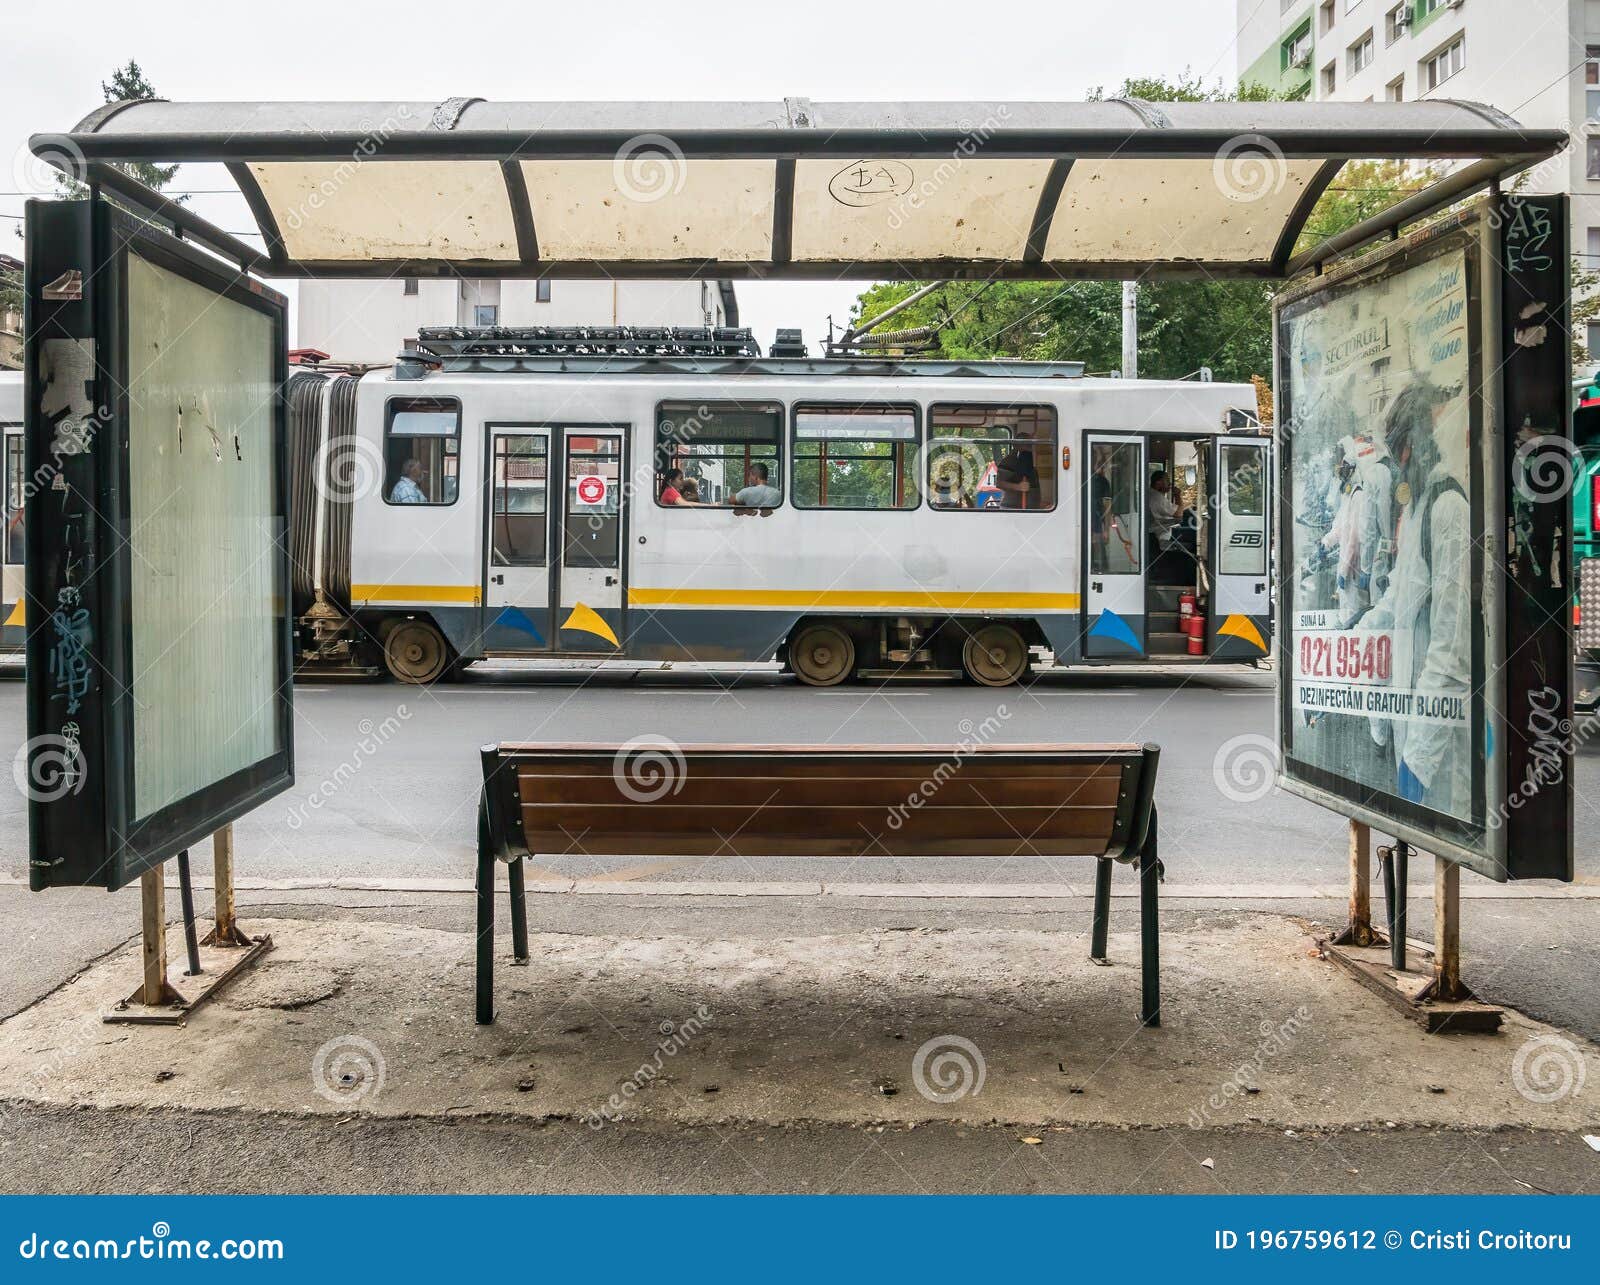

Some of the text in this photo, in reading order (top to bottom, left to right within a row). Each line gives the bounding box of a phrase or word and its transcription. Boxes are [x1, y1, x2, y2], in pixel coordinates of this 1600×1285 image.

[1325, 326, 1381, 365] SECTORUL
[1230, 532, 1262, 546] STB
[1318, 614, 1326, 626] LA
[1300, 686, 1466, 720] DEZINFECTĂM GRATUIT BLOCUL
